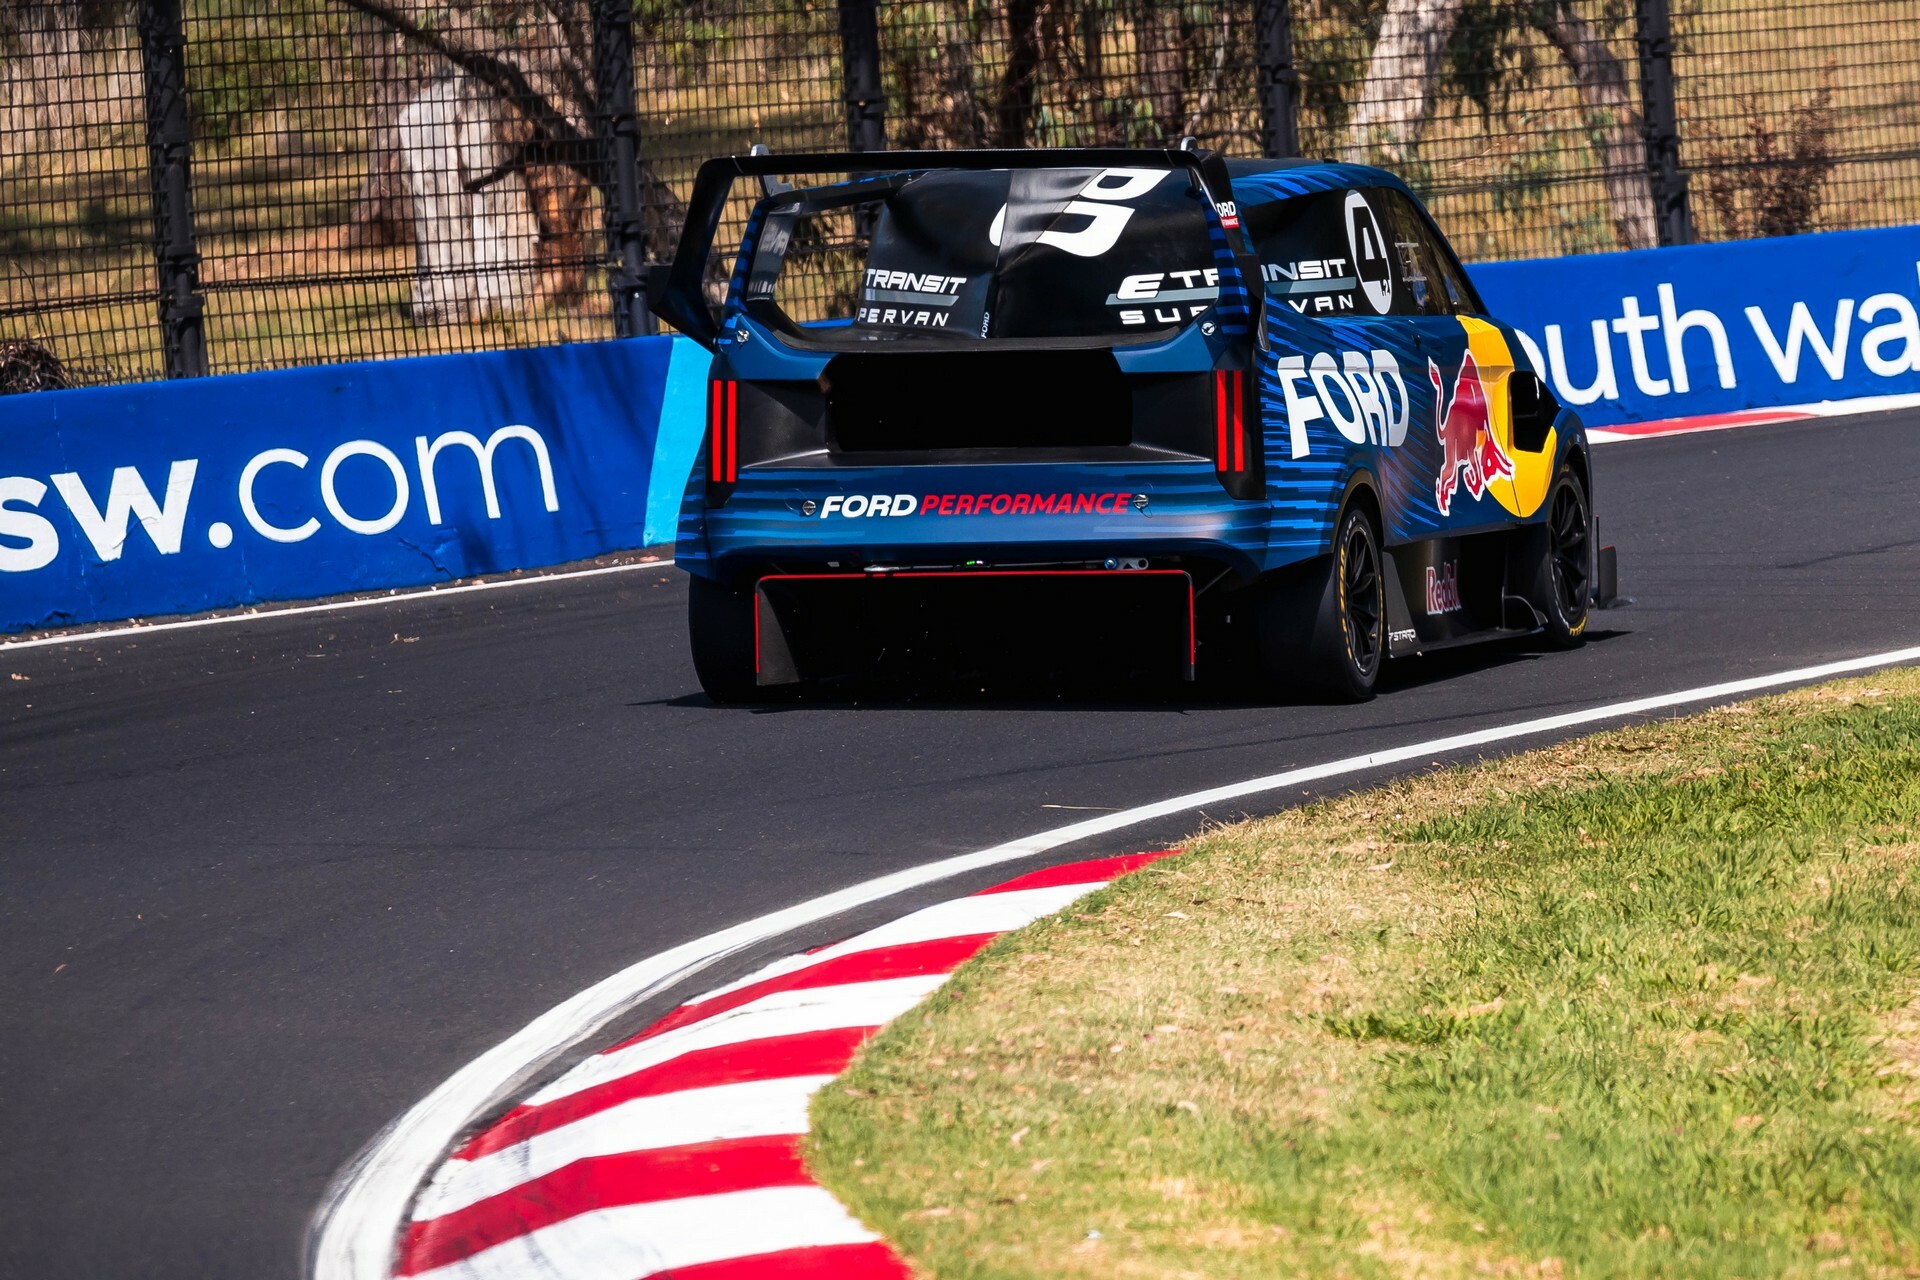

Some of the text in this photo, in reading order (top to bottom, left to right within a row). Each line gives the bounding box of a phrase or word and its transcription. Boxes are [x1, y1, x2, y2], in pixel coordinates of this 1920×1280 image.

[1215, 201, 1236, 217] ORD
[866, 268, 967, 294] TRANSIT
[1288, 294, 1354, 314] VAN
[857, 308, 949, 327] PERVAN
[1744, 261, 1920, 384] wa
[1277, 349, 1410, 460] FORD
[0, 424, 559, 572] sw.com
[820, 493, 1131, 519] FORD PERFORMANCE
